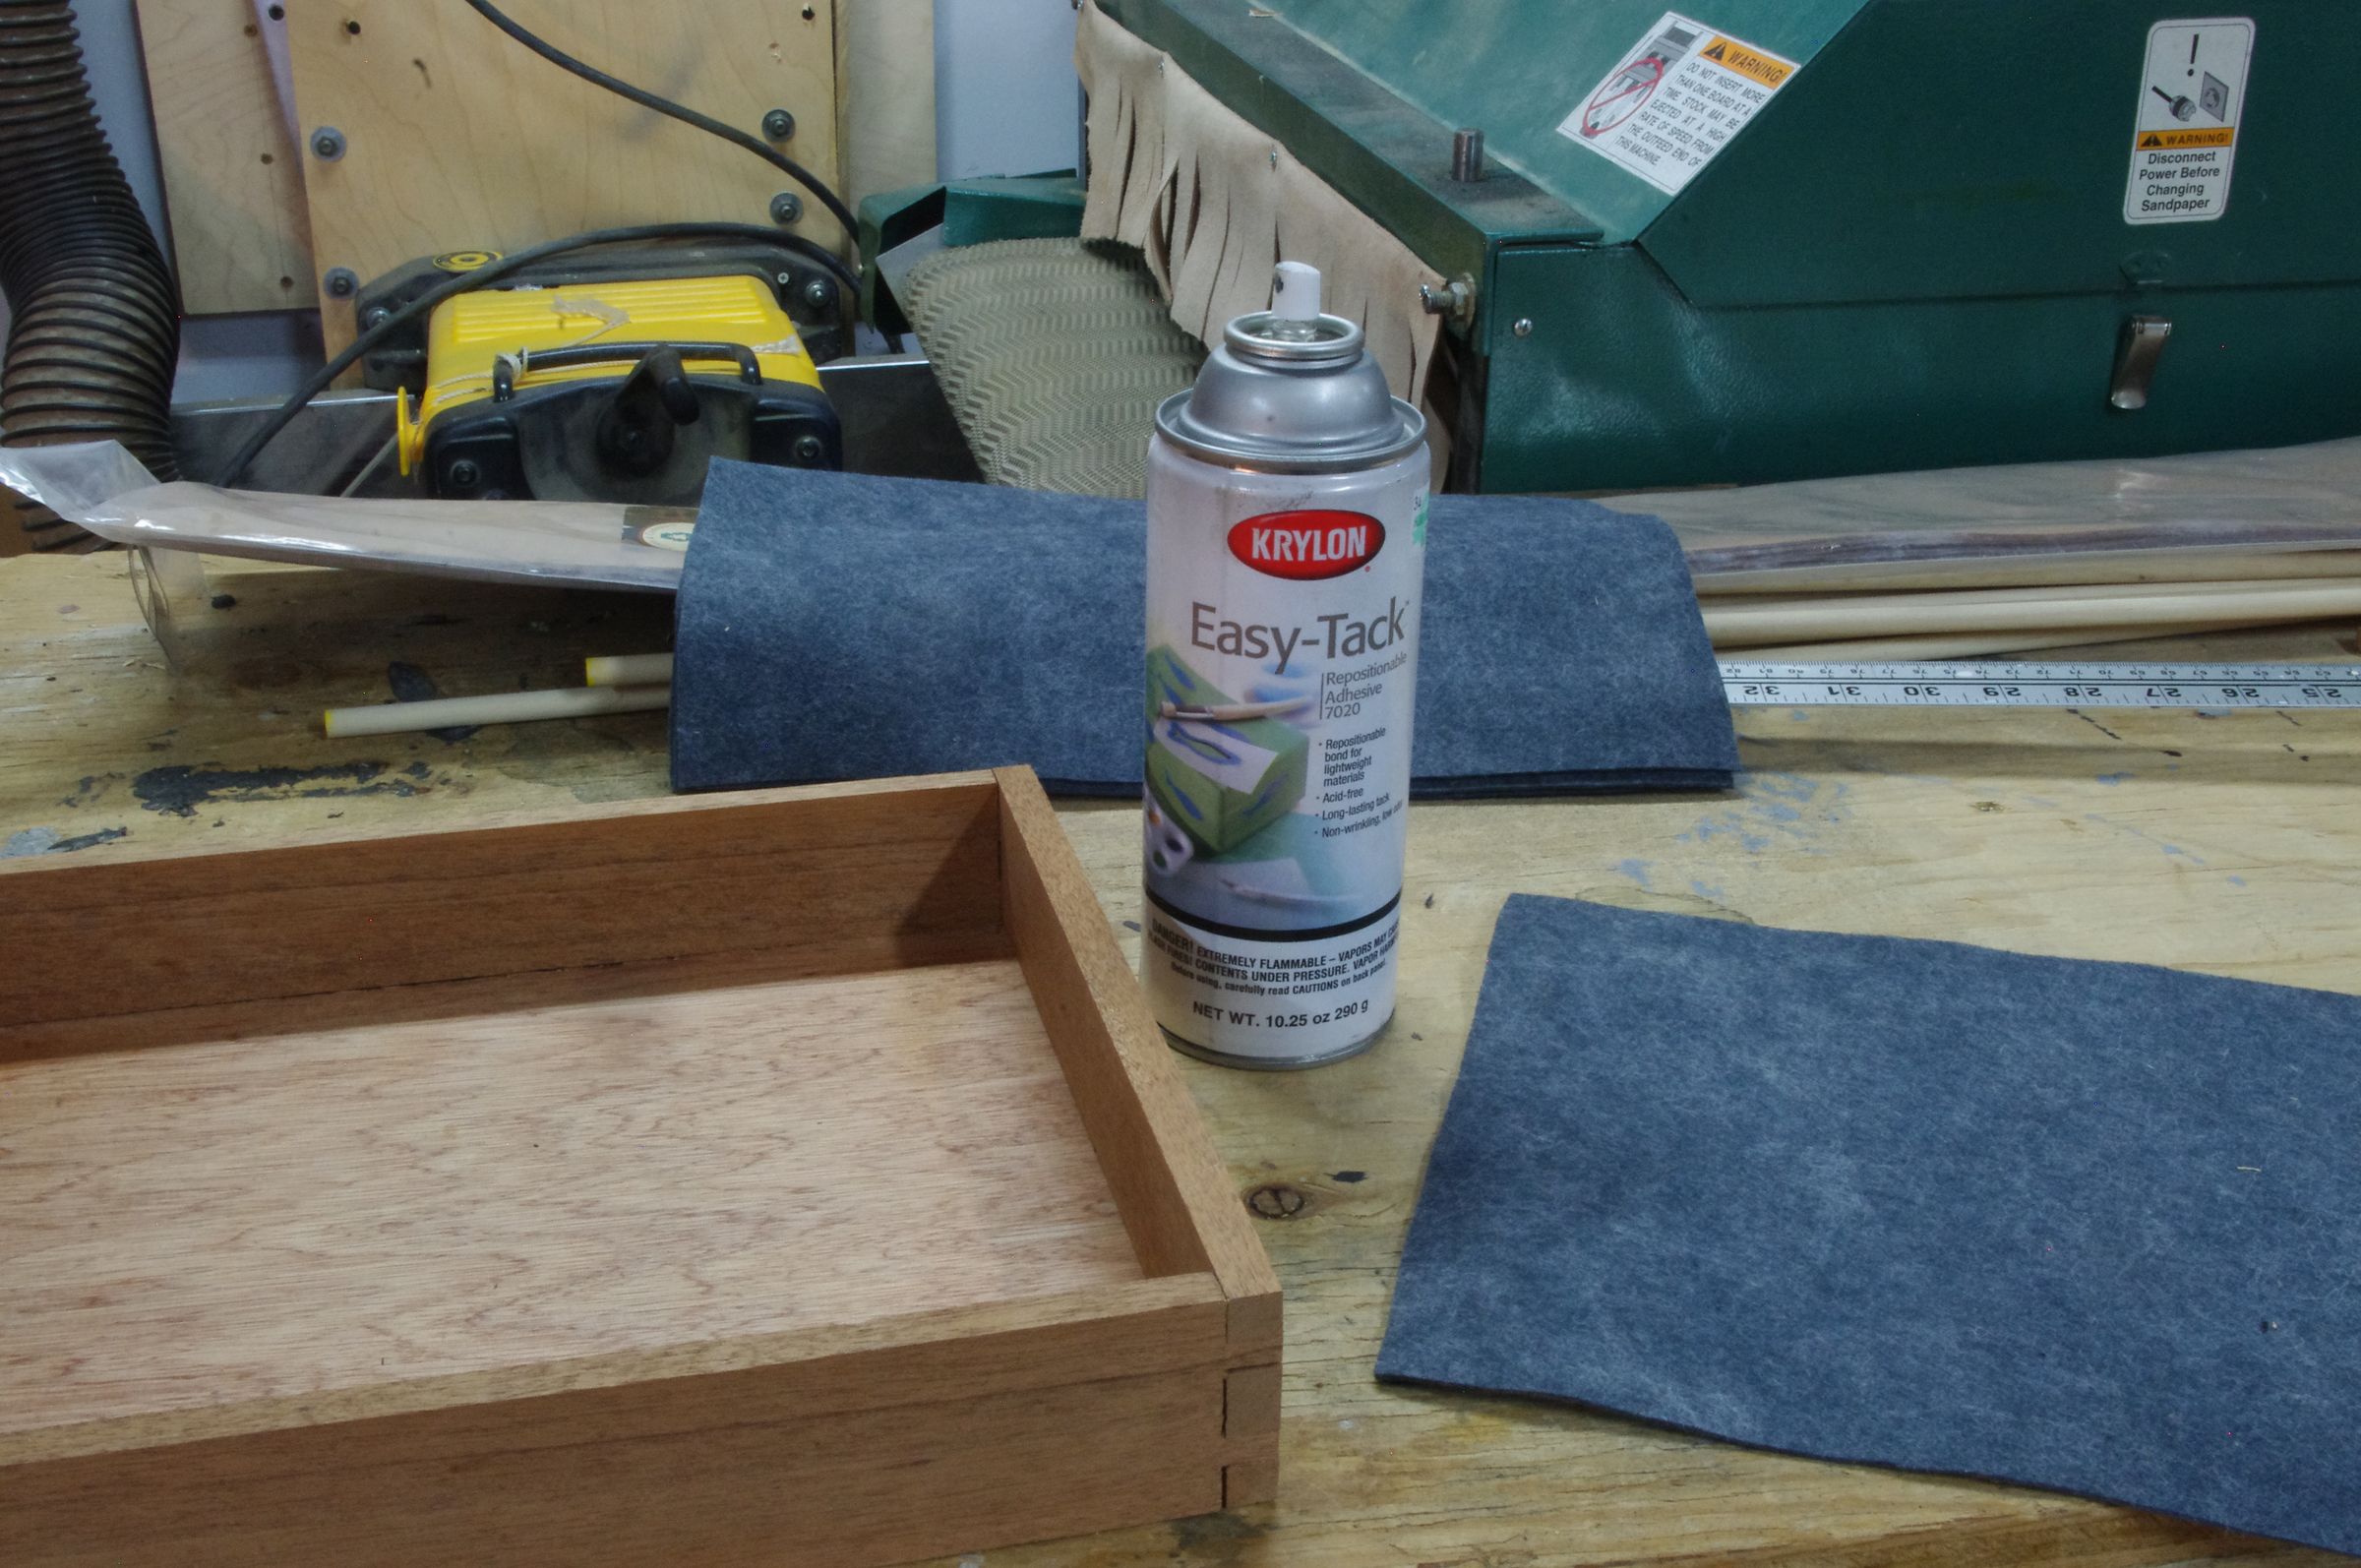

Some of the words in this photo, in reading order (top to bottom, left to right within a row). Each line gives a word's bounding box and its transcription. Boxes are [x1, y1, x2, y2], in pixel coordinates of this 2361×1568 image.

[1728, 49, 1786, 84] WARNING!
[1686, 62, 1700, 73] DO
[1700, 68, 1717, 80] NOT
[1715, 74, 1743, 92] INSERT
[1741, 88, 1766, 103] MORE
[1675, 75, 1695, 90] THAN
[1693, 83, 1709, 96] ONE
[1708, 90, 1735, 108] BOARD
[1732, 102, 1746, 112] AT
[1743, 107, 1752, 116] A
[1651, 98, 1682, 119] EJECTED
[1682, 116, 1696, 125] AT
[1696, 122, 1706, 132] A
[1706, 128, 1726, 143] HIGH
[1682, 96, 1709, 114] STOCK
[1708, 108, 1726, 122] MAY
[1725, 118, 1740, 130] BE
[1639, 111, 1659, 127] RATE
[1658, 121, 1670, 131] OF
[1668, 126, 1693, 145] SPEED
[1692, 139, 1716, 155] FROM
[2166, 134, 2228, 145] WARNING!
[1615, 136, 1633, 150] THIS
[1628, 124, 1643, 137] THE
[1641, 132, 1672, 152] OUTFEED
[1671, 148, 1690, 162] END
[1688, 157, 1702, 167] OF
[2149, 151, 2215, 164] Disconnect
[2139, 169, 2176, 181] Power
[2180, 167, 2219, 179] Before
[2147, 184, 2204, 197] Changing
[2142, 199, 2210, 212] Sandpaper
[1251, 526, 1366, 562] KRYLON
[1191, 596, 1405, 675] Easy-Tack
[1326, 651, 1407, 687] Repositionable
[1325, 683, 1382, 704] Adhesive
[1743, 686, 1780, 695] 32
[1828, 686, 1861, 695] 31
[1904, 686, 1941, 696] 30
[1983, 687, 2021, 696] 29
[2064, 687, 2102, 696] 28
[2147, 688, 2181, 697] 27
[2222, 688, 2260, 697] 26
[2302, 688, 2341, 697] 25
[1324, 702, 1361, 719] 7020
[1326, 728, 1385, 750] Repositionable
[1324, 750, 1348, 761] bond
[1351, 748, 1362, 757] for
[1324, 755, 1371, 776] lightweight
[1324, 771, 1364, 787] materials
[1322, 788, 1363, 803] Acid-free
[1322, 801, 1374, 820] Long-lasting
[1376, 793, 1389, 807] tack
[1152, 919, 1193, 952] DANGER!
[1197, 946, 1256, 968] EXTREMELY
[1260, 955, 1326, 970] FLAMMABLE
[1338, 941, 1371, 962] VAPORS
[1373, 931, 1387, 948] MAY
[1195, 958, 1248, 980] CONTENTS
[1251, 972, 1291, 983] UNDER
[1293, 964, 1350, 983] PRESSURE.
[1354, 950, 1378, 969] VAPOR
[1225, 982, 1265, 996] carefully
[1268, 986, 1290, 995] read
[1293, 980, 1338, 995] CAUTIONS
[1341, 978, 1351, 987] on
[1353, 970, 1369, 984] back
[1193, 1000, 1224, 1021] NET
[1230, 1012, 1259, 1027] WT.
[1266, 1014, 1308, 1028] 10.25
[1312, 1013, 1330, 1025] oz
[1334, 1001, 1358, 1021] 290
[1361, 998, 1368, 1013] g
